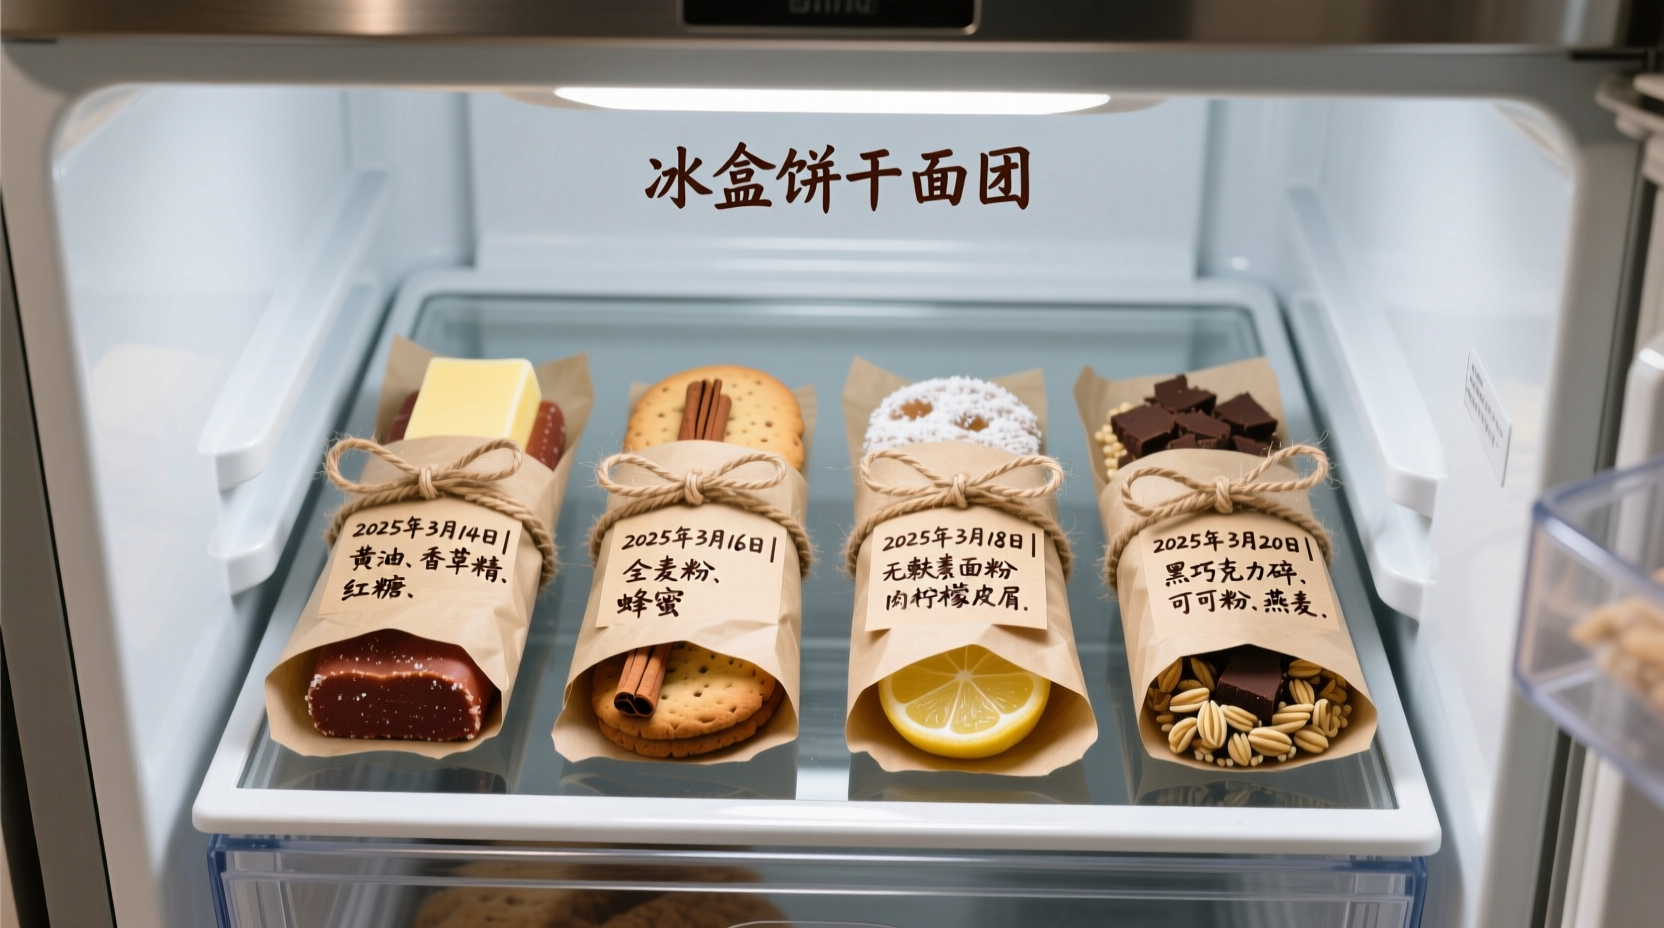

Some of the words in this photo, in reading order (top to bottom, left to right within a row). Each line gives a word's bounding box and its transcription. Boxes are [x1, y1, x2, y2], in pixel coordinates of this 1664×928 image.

[644, 141, 1031, 214] 冰盒饼干面团
[616, 586, 684, 619] 蜂蜜
